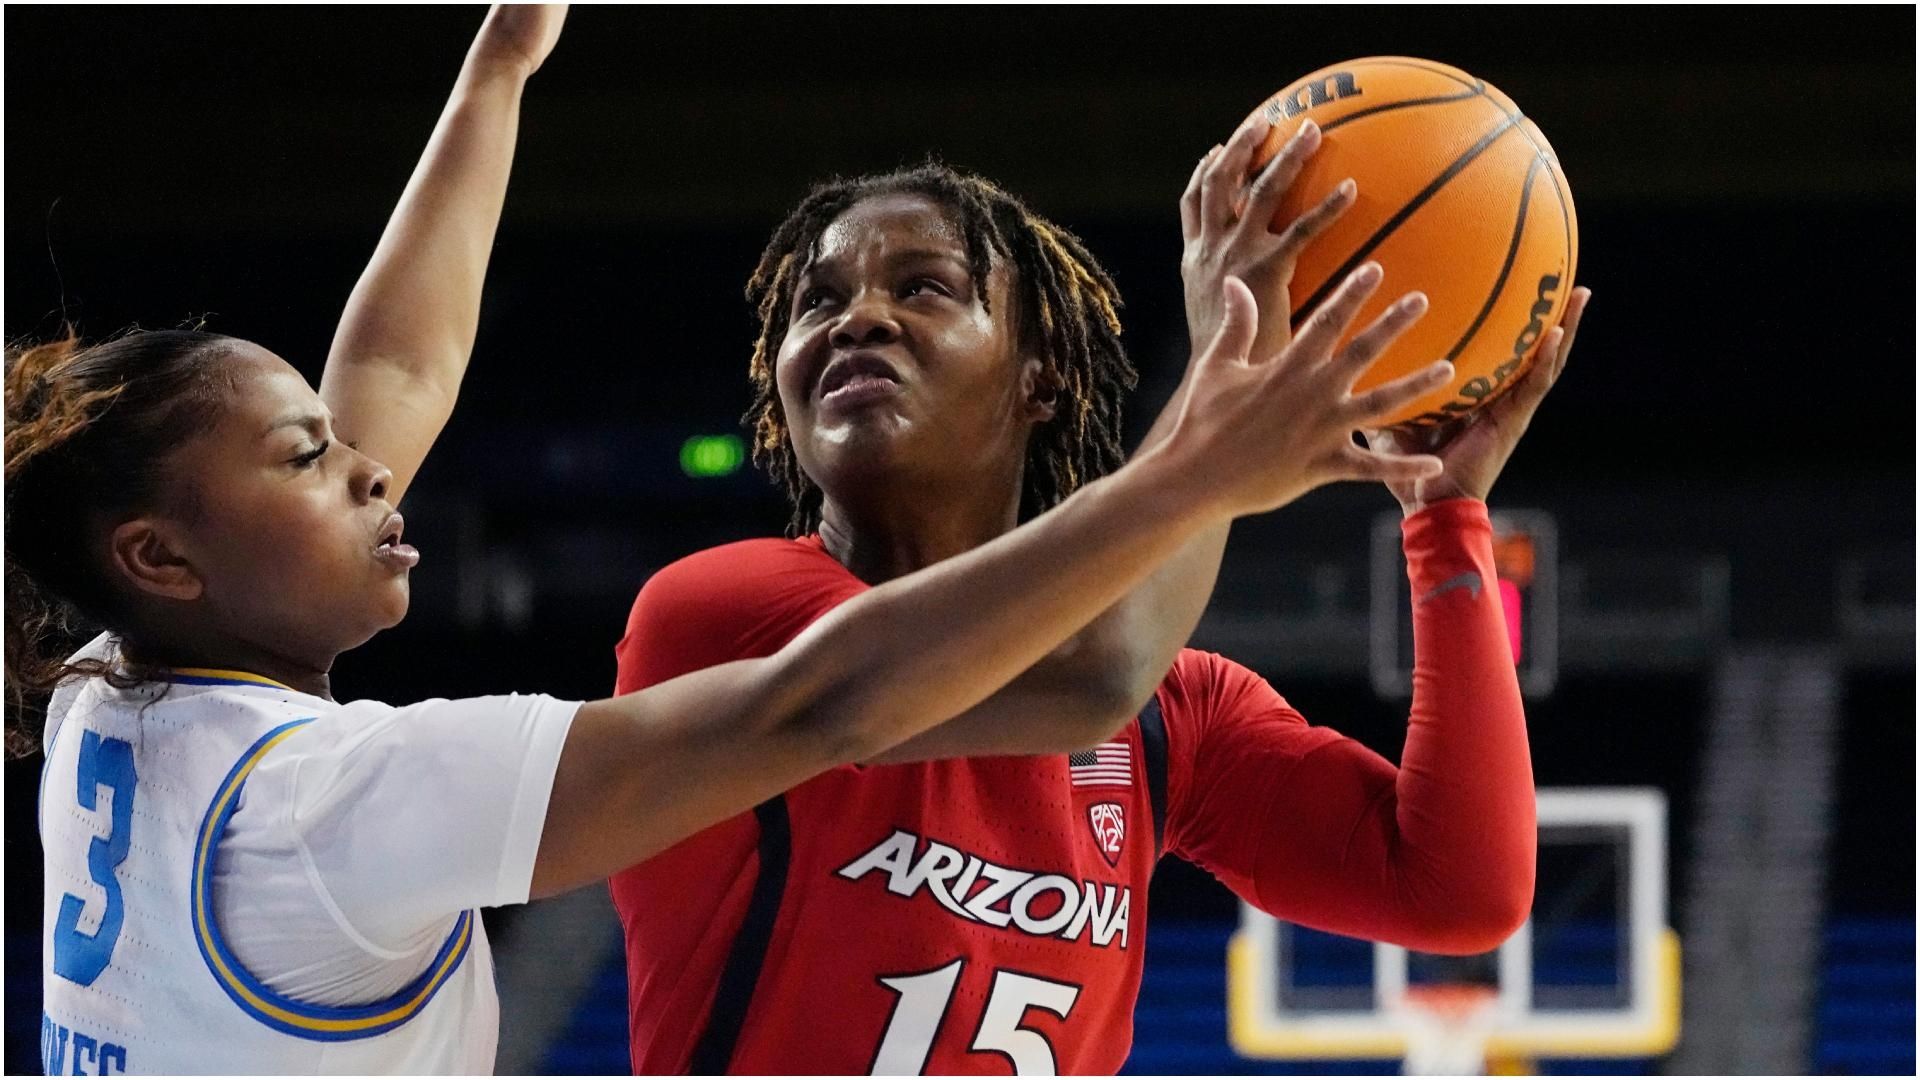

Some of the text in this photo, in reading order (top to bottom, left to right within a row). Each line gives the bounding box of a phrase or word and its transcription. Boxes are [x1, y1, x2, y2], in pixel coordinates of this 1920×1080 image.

[54, 728, 138, 987] 3
[1090, 803, 1124, 841] PAC
[1102, 827, 1121, 852] 12
[836, 828, 1131, 949] ARIZONA
[870, 957, 1082, 1076] 15
